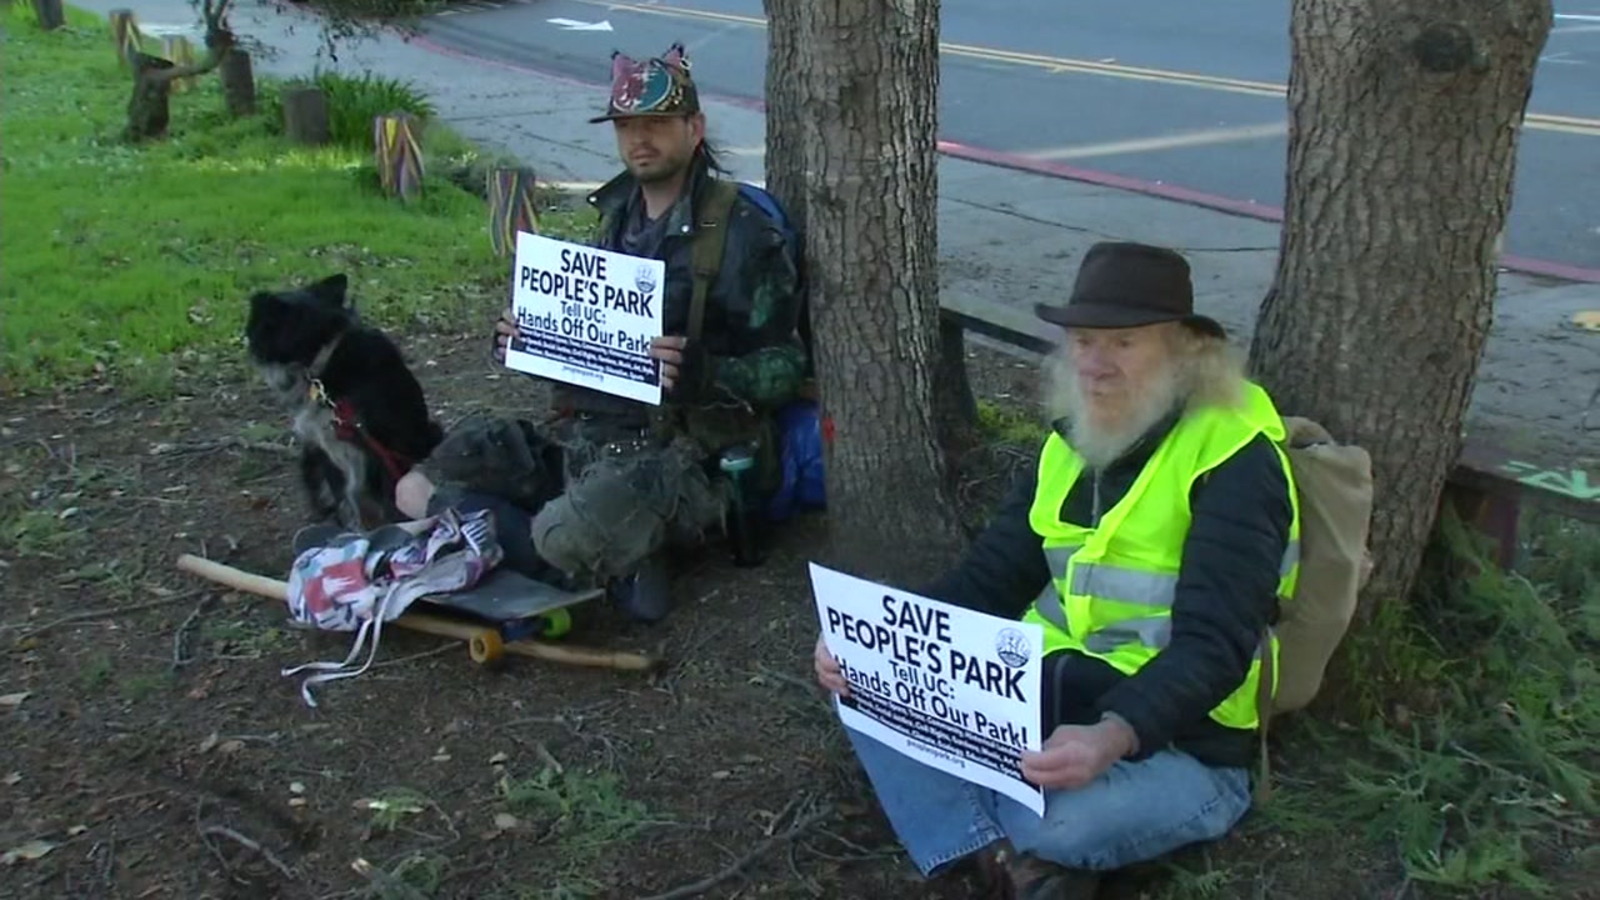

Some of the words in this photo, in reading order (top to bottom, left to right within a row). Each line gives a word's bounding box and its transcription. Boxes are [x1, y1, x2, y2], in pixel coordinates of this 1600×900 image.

[560, 248, 607, 281] SAVE
[520, 265, 600, 306] PEOPLE'S
[603, 284, 655, 319] PARK
[560, 300, 581, 318] Tell
[584, 306, 607, 325] UC:
[517, 305, 559, 333] Hands
[561, 316, 584, 338] Off
[587, 323, 615, 347] Our
[882, 595, 952, 643] SAVE
[826, 605, 942, 675] PEOPLE'S
[949, 649, 1028, 704] PARK
[834, 654, 892, 698] Hands
[895, 682, 927, 712] Off
[932, 696, 970, 728] Our
[974, 710, 1028, 750] Park!
[889, 659, 919, 685] Tell
[923, 674, 956, 700] UC:
